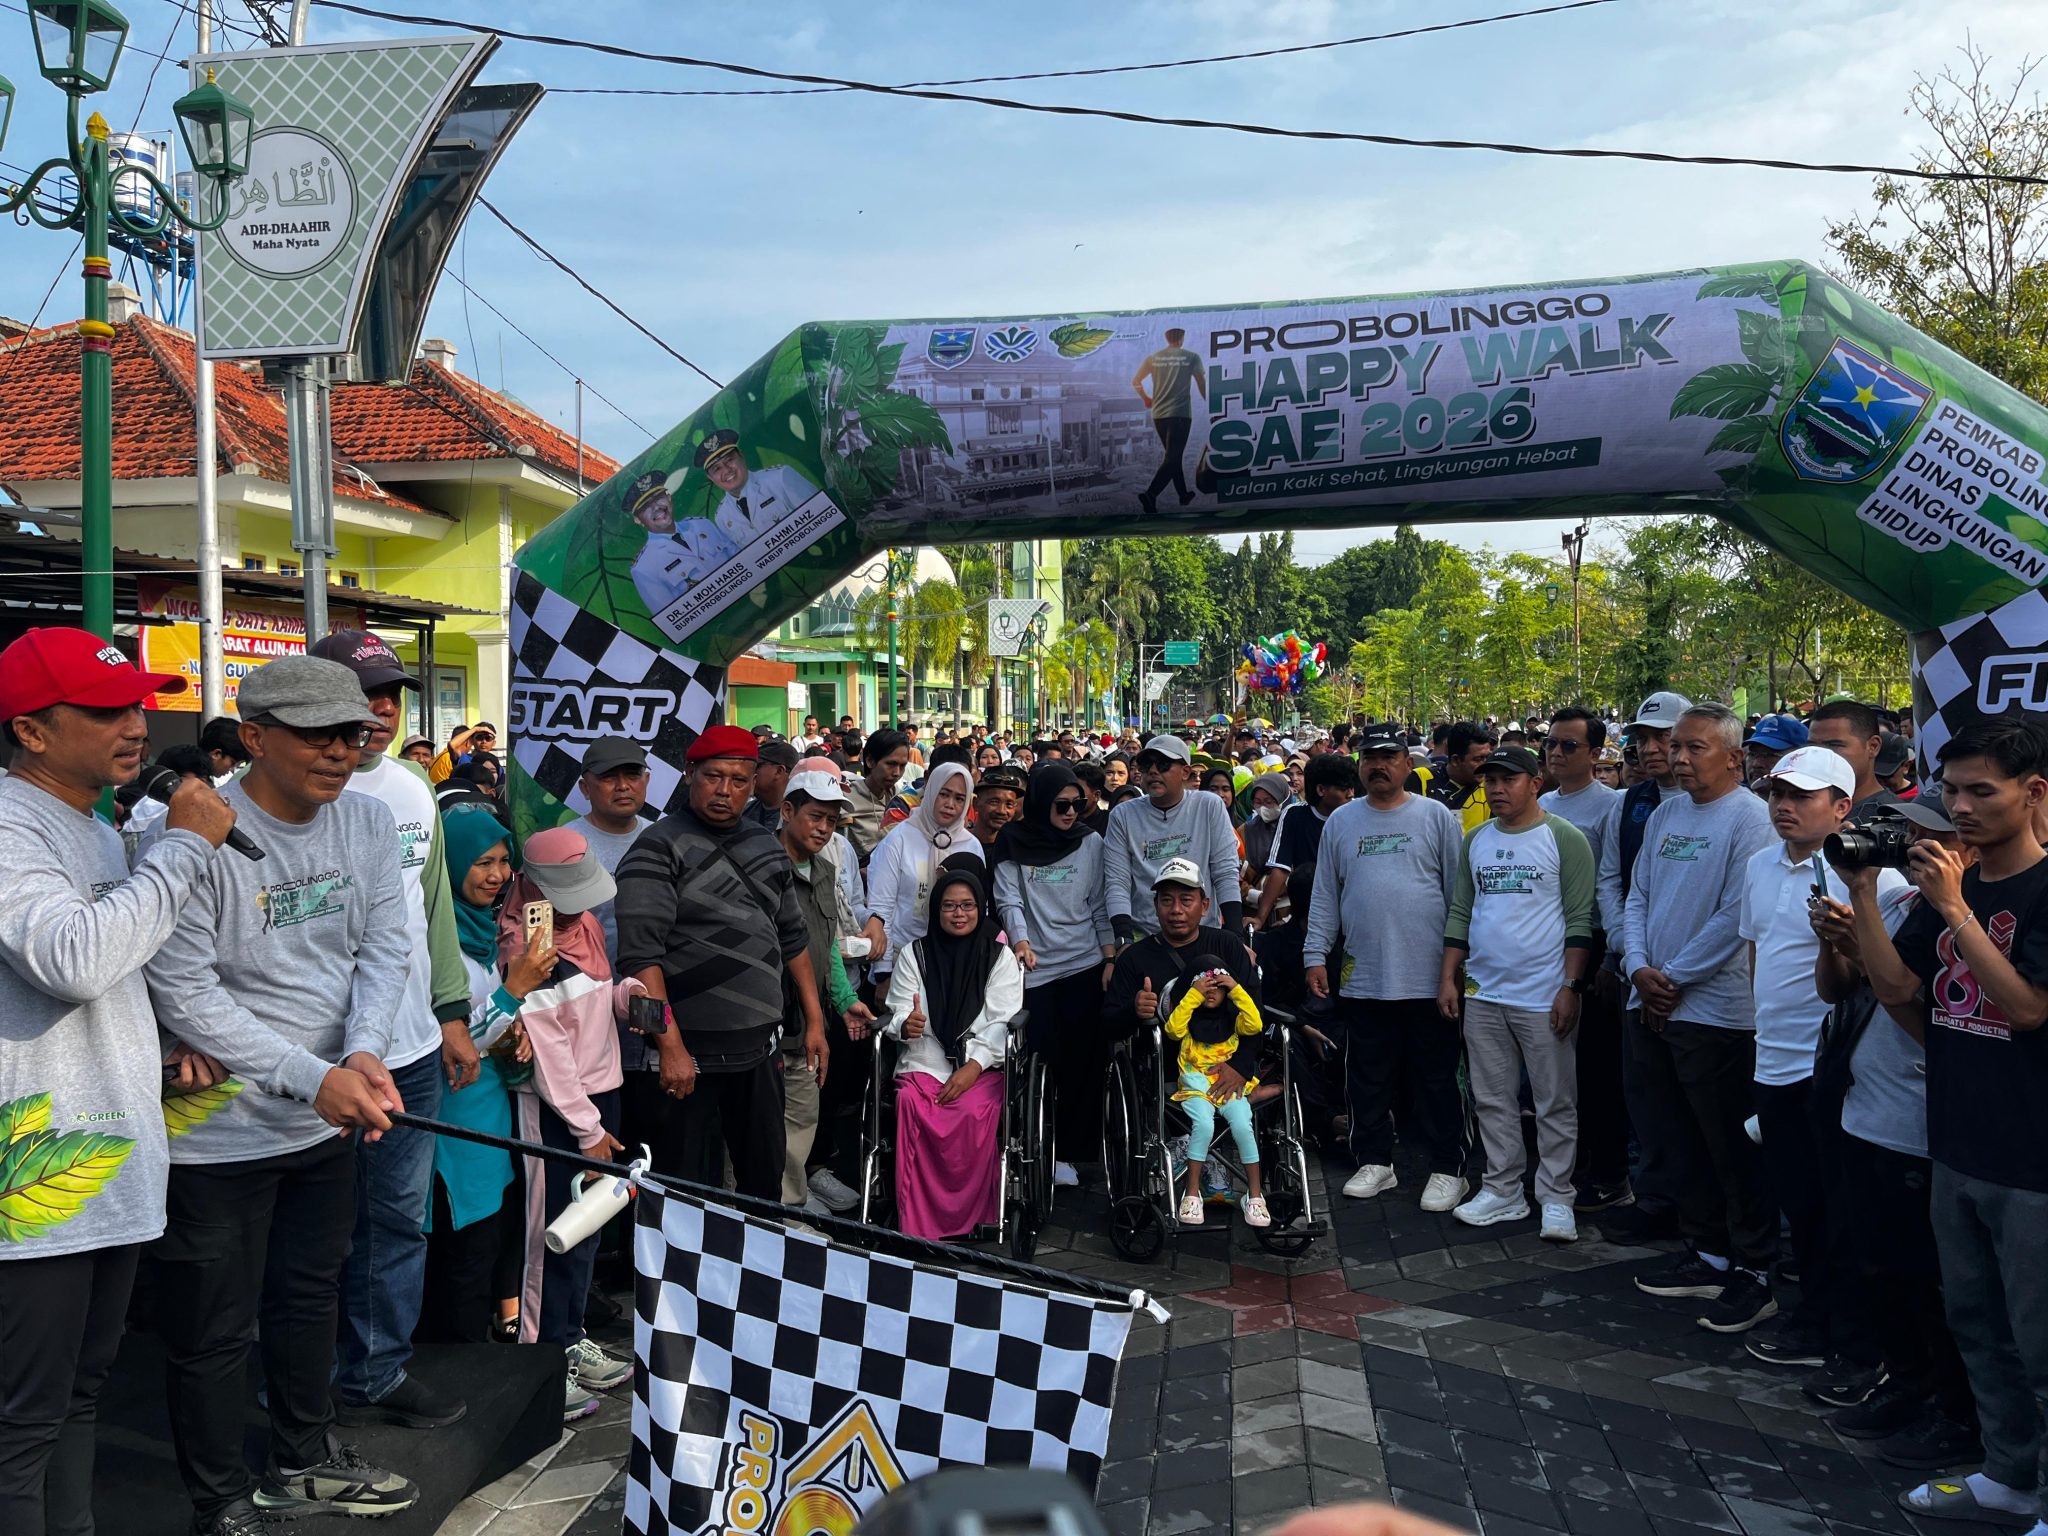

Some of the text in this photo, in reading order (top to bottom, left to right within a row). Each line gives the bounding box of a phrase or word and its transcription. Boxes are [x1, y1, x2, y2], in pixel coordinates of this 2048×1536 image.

[241, 221, 331, 236] ADH-DHAAHIR
[253, 238, 320, 250] Maha Nyata
[1210, 292, 1612, 358] PROBOLINGGO
[1208, 312, 1679, 416] HAPPY WALK
[1208, 387, 1537, 472] SAE 2026
[1938, 404, 2040, 475] PEMKAB
[1225, 445, 1579, 497] Jalan Kaki Sehat, Lingkungan Hebat
[1903, 451, 1982, 506] DINAS
[1922, 427, 2048, 518] PROBOLIN
[756, 507, 838, 569] WABUP PROBOLINGGO
[764, 509, 815, 549] FAHMI AHZ
[1864, 498, 1942, 546] HIDUP
[1884, 475, 2046, 579] LINGKUNGAN
[666, 562, 745, 623] DR. H. MOH HARIS
[674, 571, 753, 631] BUPATI PROBOLINGGO
[222, 637, 251, 654] ARAT
[235, 609, 269, 632] SATE
[509, 688, 670, 734] START
[1481, 864, 1538, 872] PROBOLINGGO
[1482, 870, 1546, 881] HAPPY WALK
[89, 1111, 126, 1122] GREEN
[729, 1413, 775, 1536] PRO
